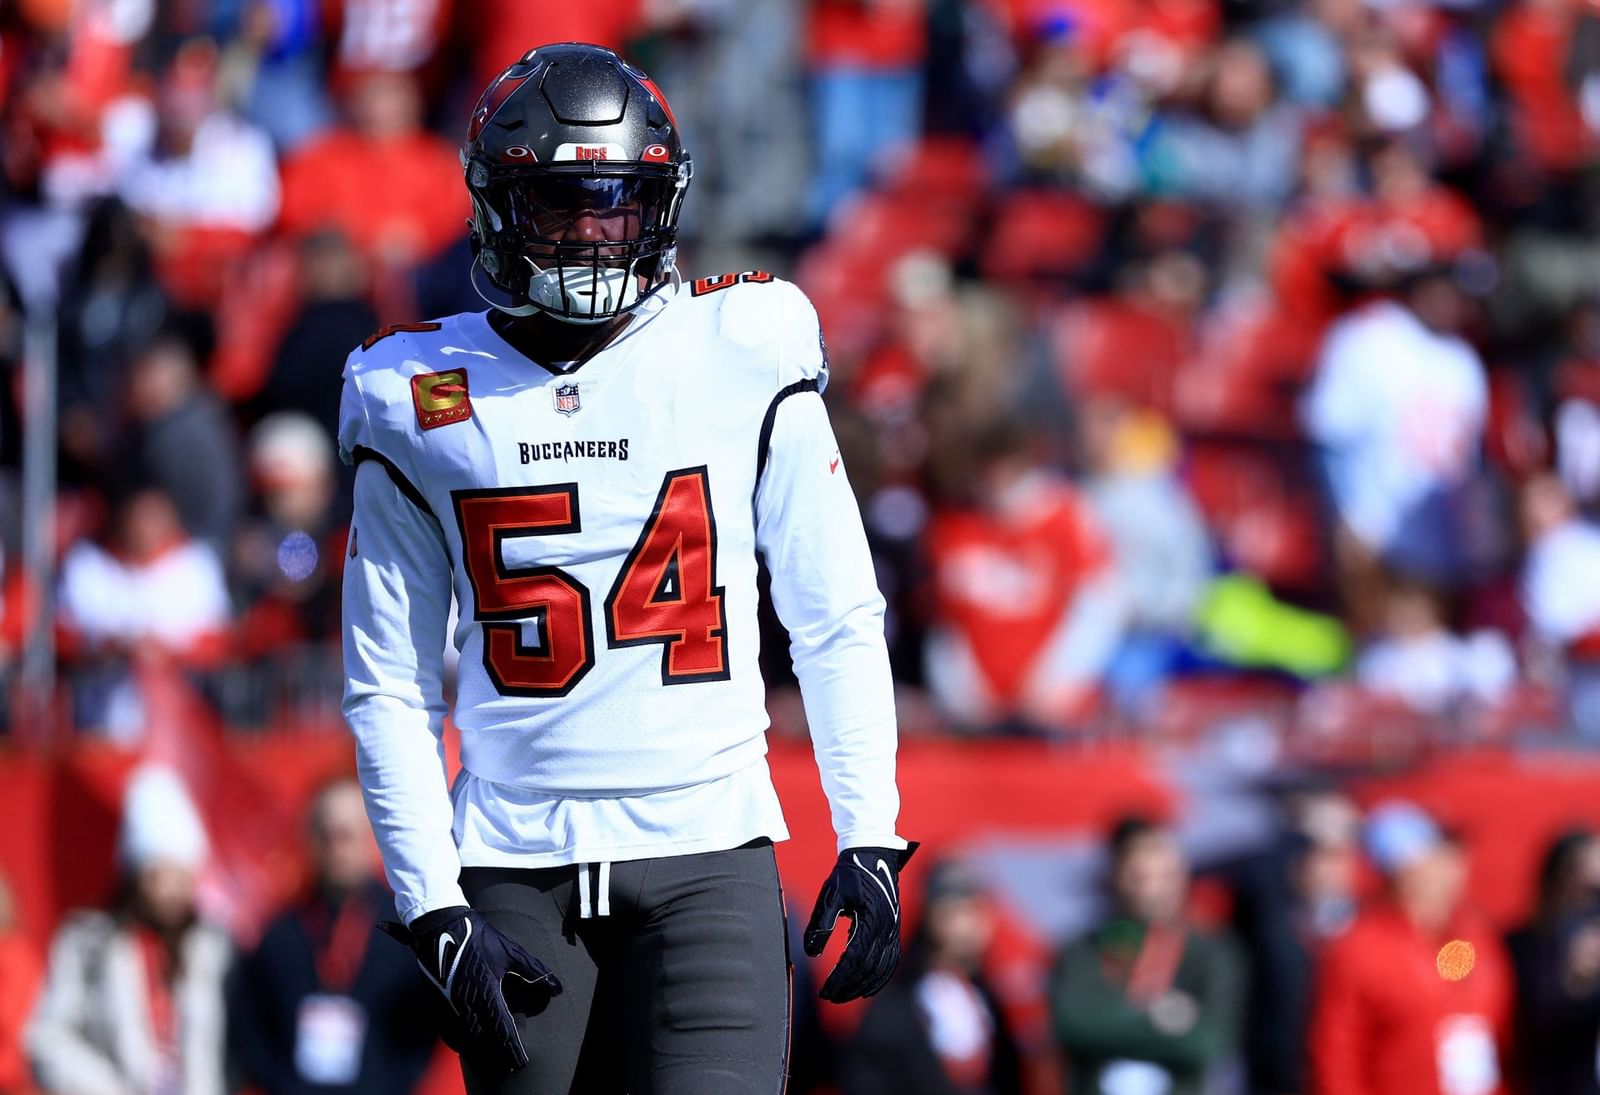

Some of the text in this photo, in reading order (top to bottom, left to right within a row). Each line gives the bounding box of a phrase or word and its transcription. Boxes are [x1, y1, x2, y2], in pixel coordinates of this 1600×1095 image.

[418, 373, 464, 412] C
[558, 396, 578, 409] NFL
[518, 439, 629, 464] BUCCANEERS
[450, 464, 731, 697] 54
